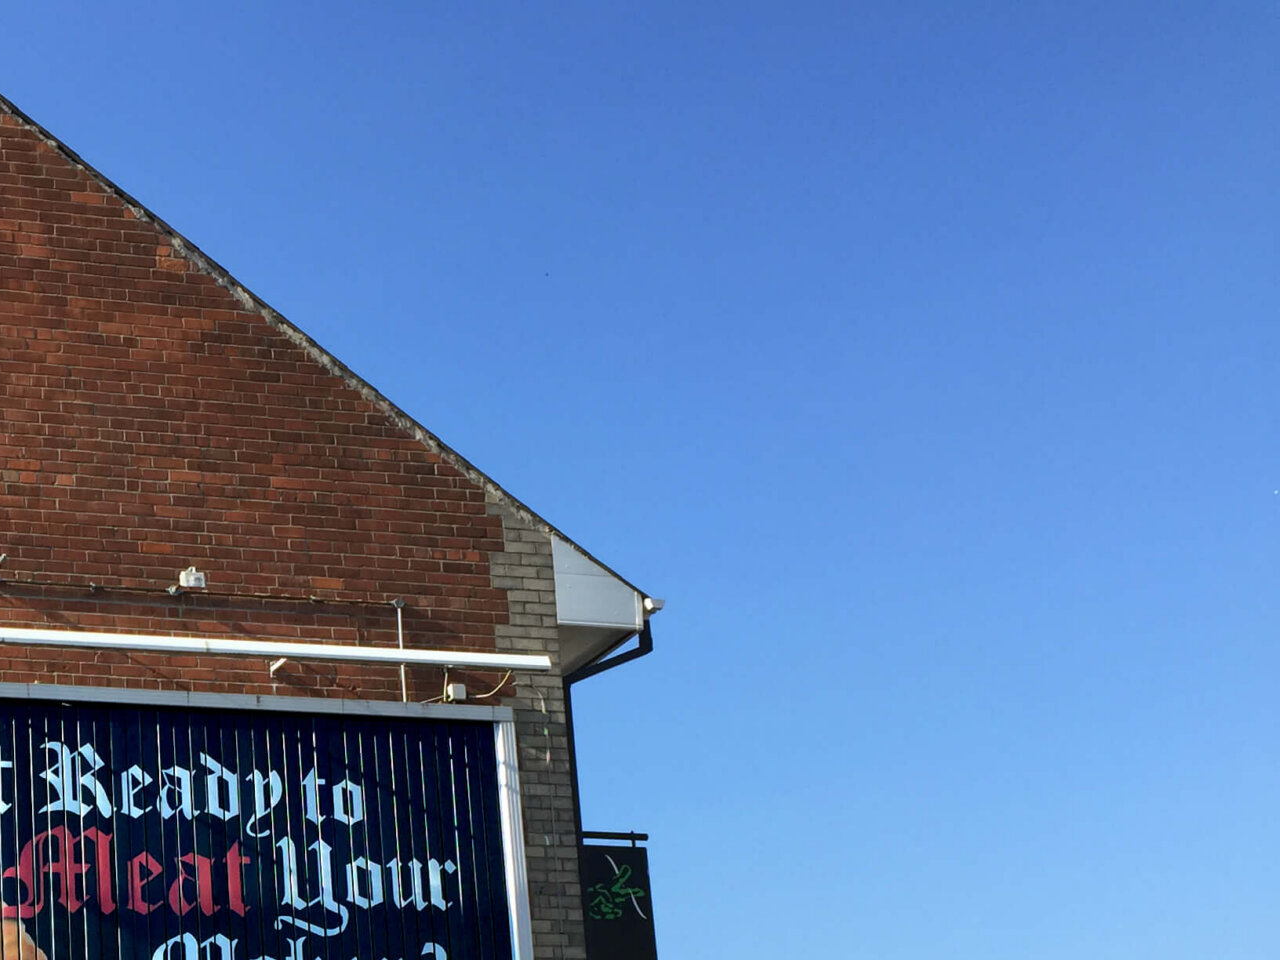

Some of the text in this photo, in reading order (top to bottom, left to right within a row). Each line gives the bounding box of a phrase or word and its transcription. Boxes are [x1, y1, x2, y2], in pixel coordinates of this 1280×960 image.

[38, 741, 284, 838] Ready
[302, 766, 365, 826] to
[274, 836, 457, 937] Your
